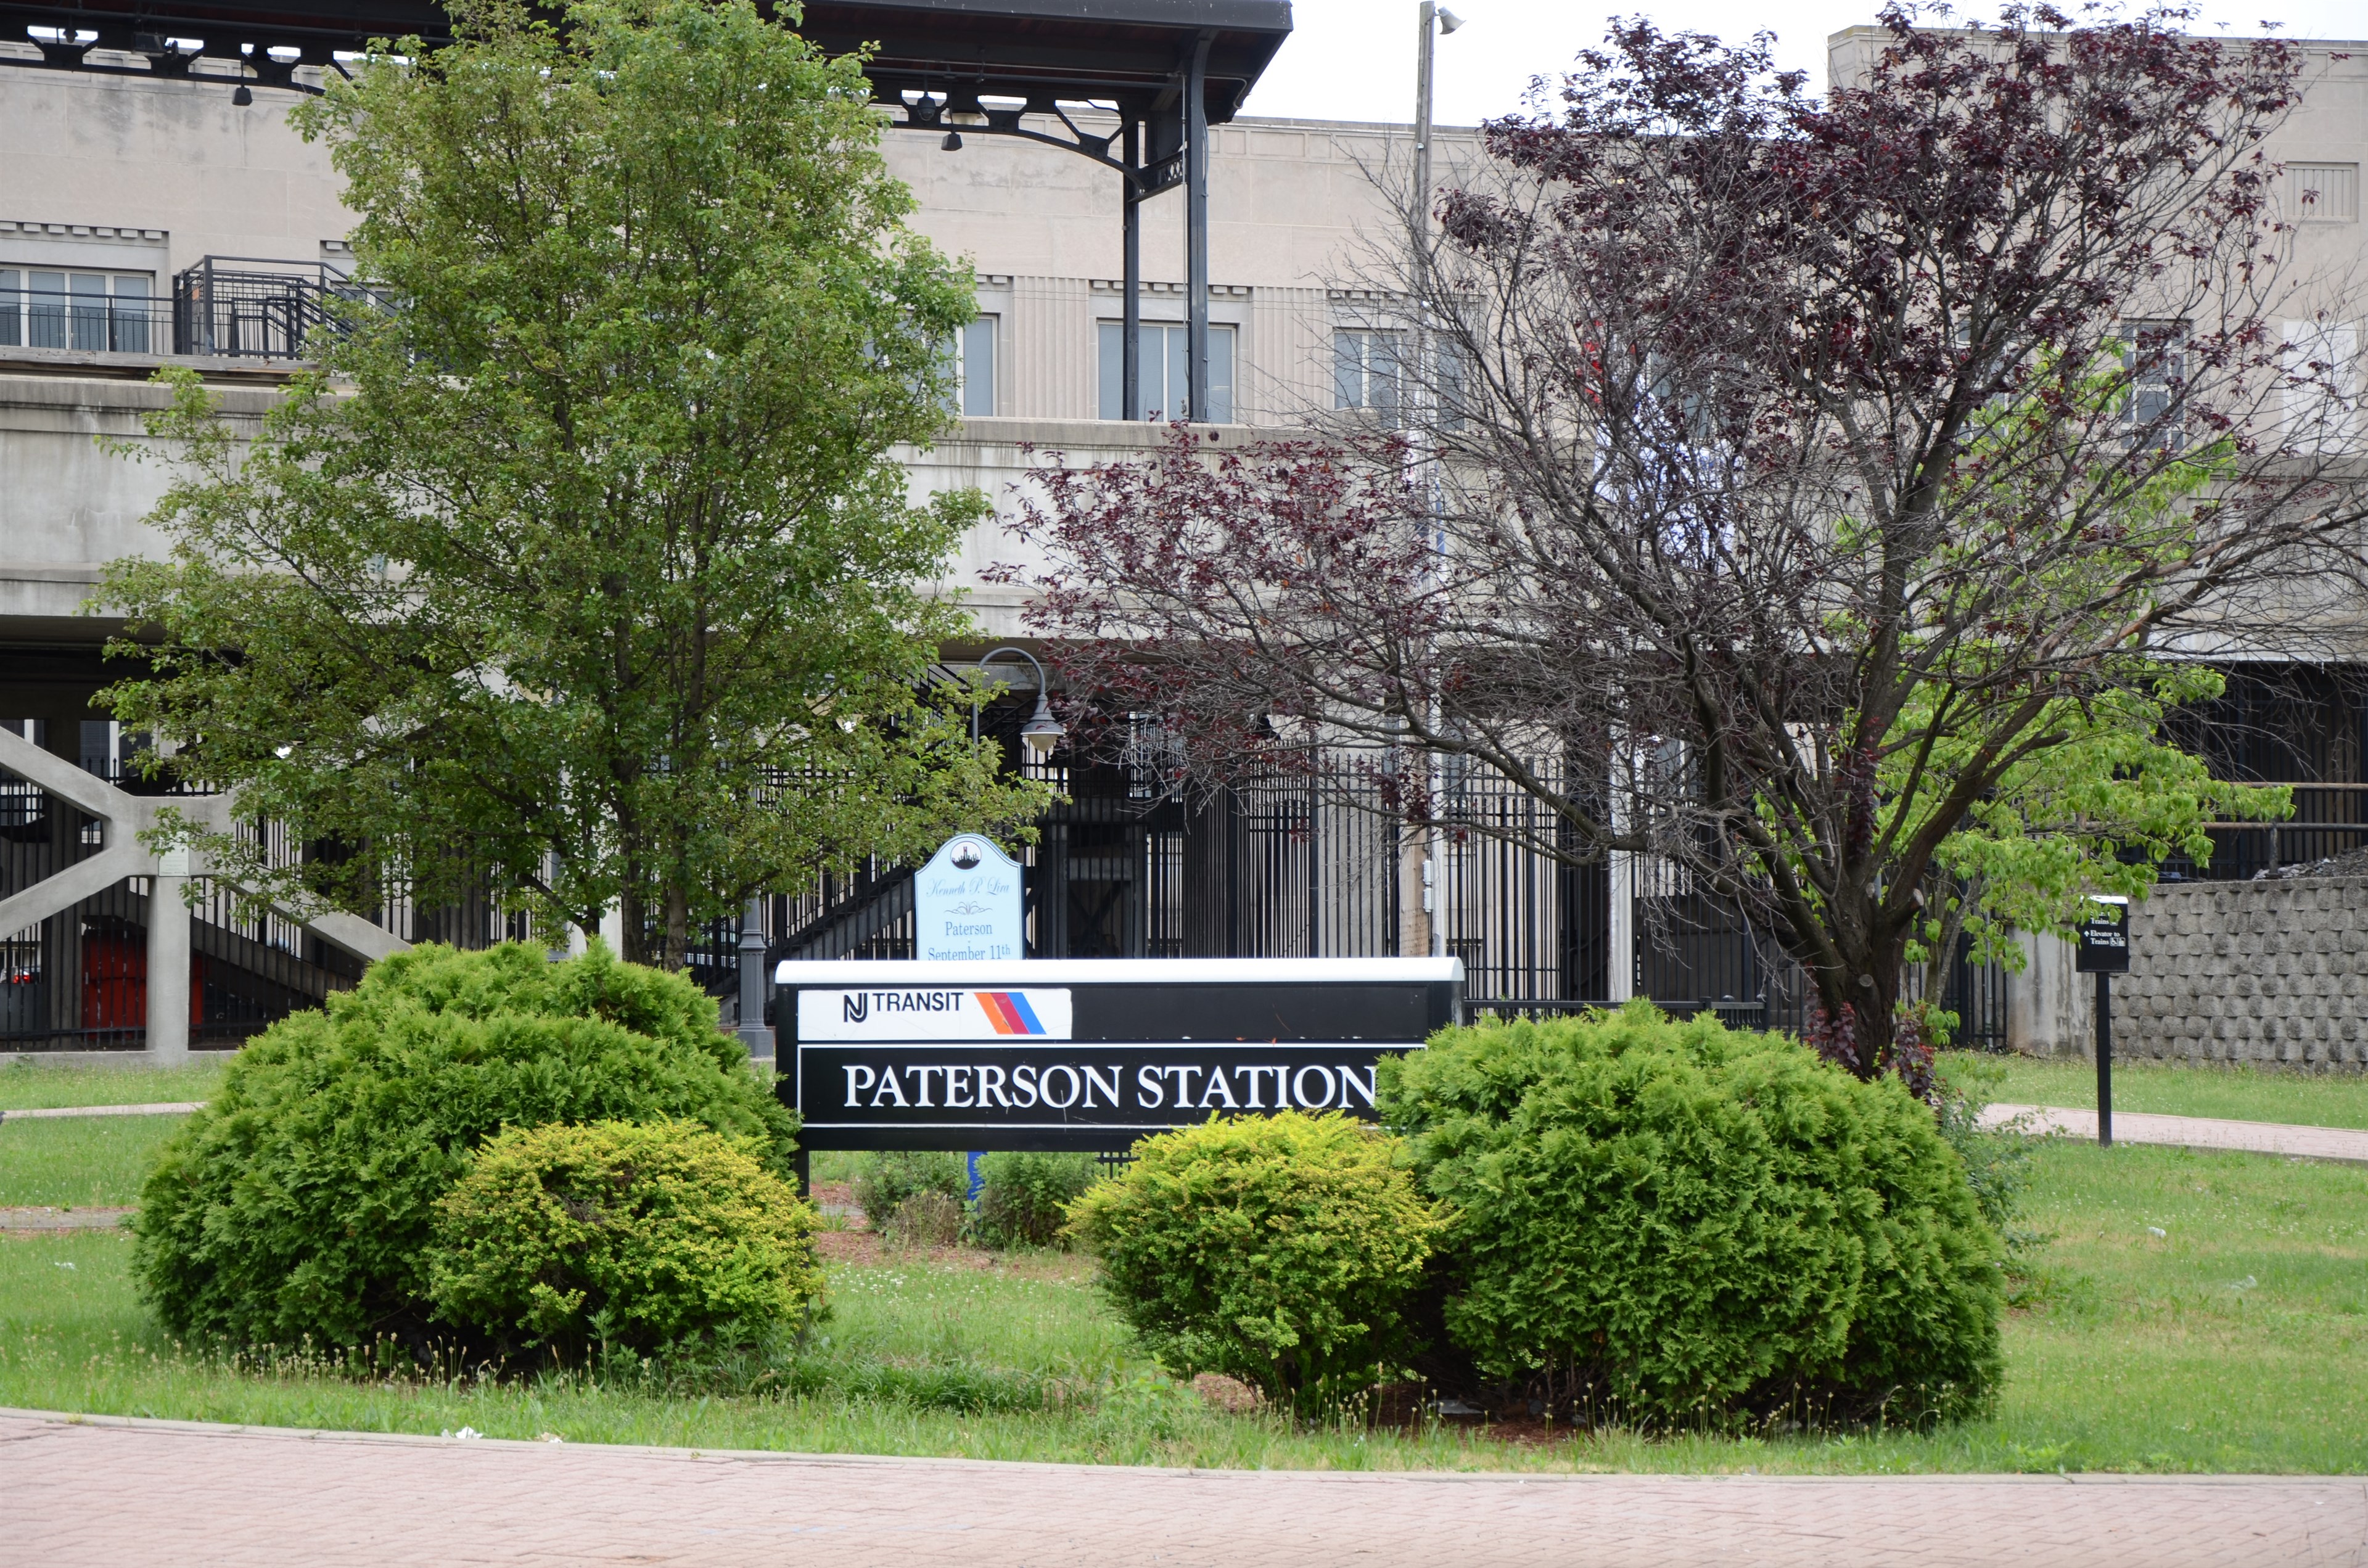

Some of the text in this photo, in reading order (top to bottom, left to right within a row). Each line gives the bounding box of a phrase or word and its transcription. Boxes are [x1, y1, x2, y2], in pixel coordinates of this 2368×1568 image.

[926, 878, 966, 897] Kenneth
[945, 921, 993, 935] Paterson
[927, 943, 1011, 961] September 11th
[873, 993, 963, 1011] TRANSIT
[842, 1064, 1376, 1109] PATERSON STATION
